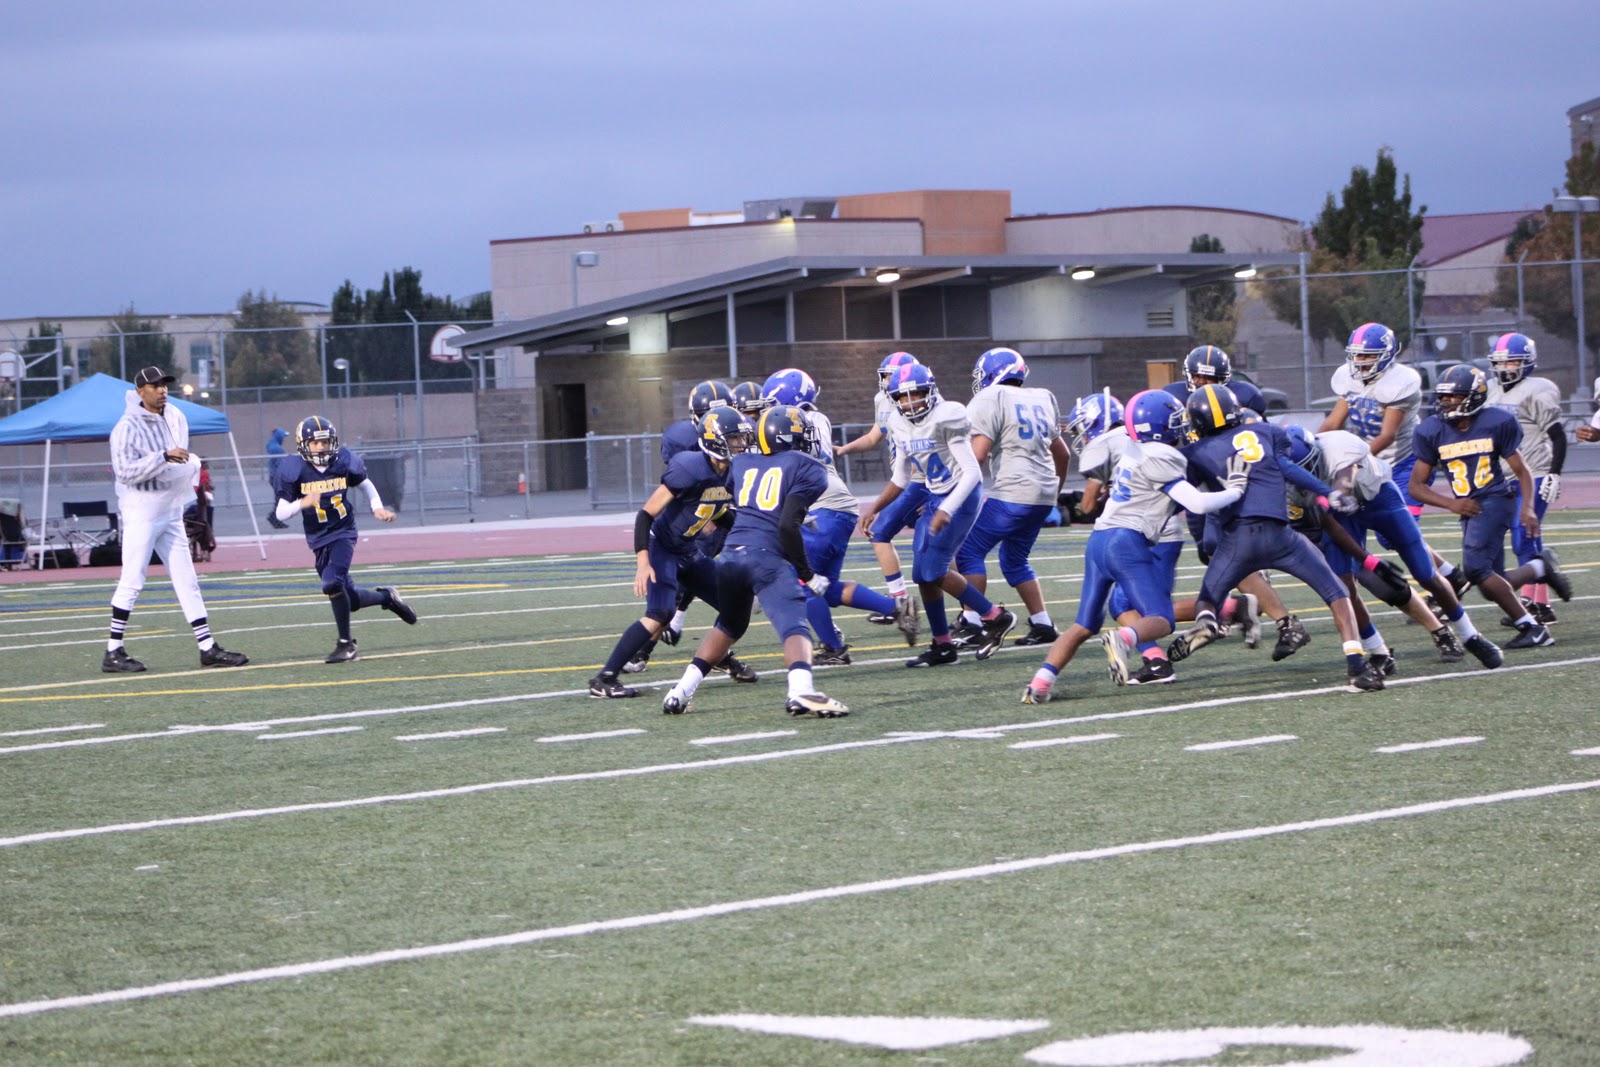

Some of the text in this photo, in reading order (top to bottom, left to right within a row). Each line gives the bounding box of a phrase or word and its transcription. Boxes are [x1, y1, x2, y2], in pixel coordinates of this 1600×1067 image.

[1231, 430, 1265, 464] 3
[738, 466, 784, 512] 10
[1446, 455, 1495, 497] 34
